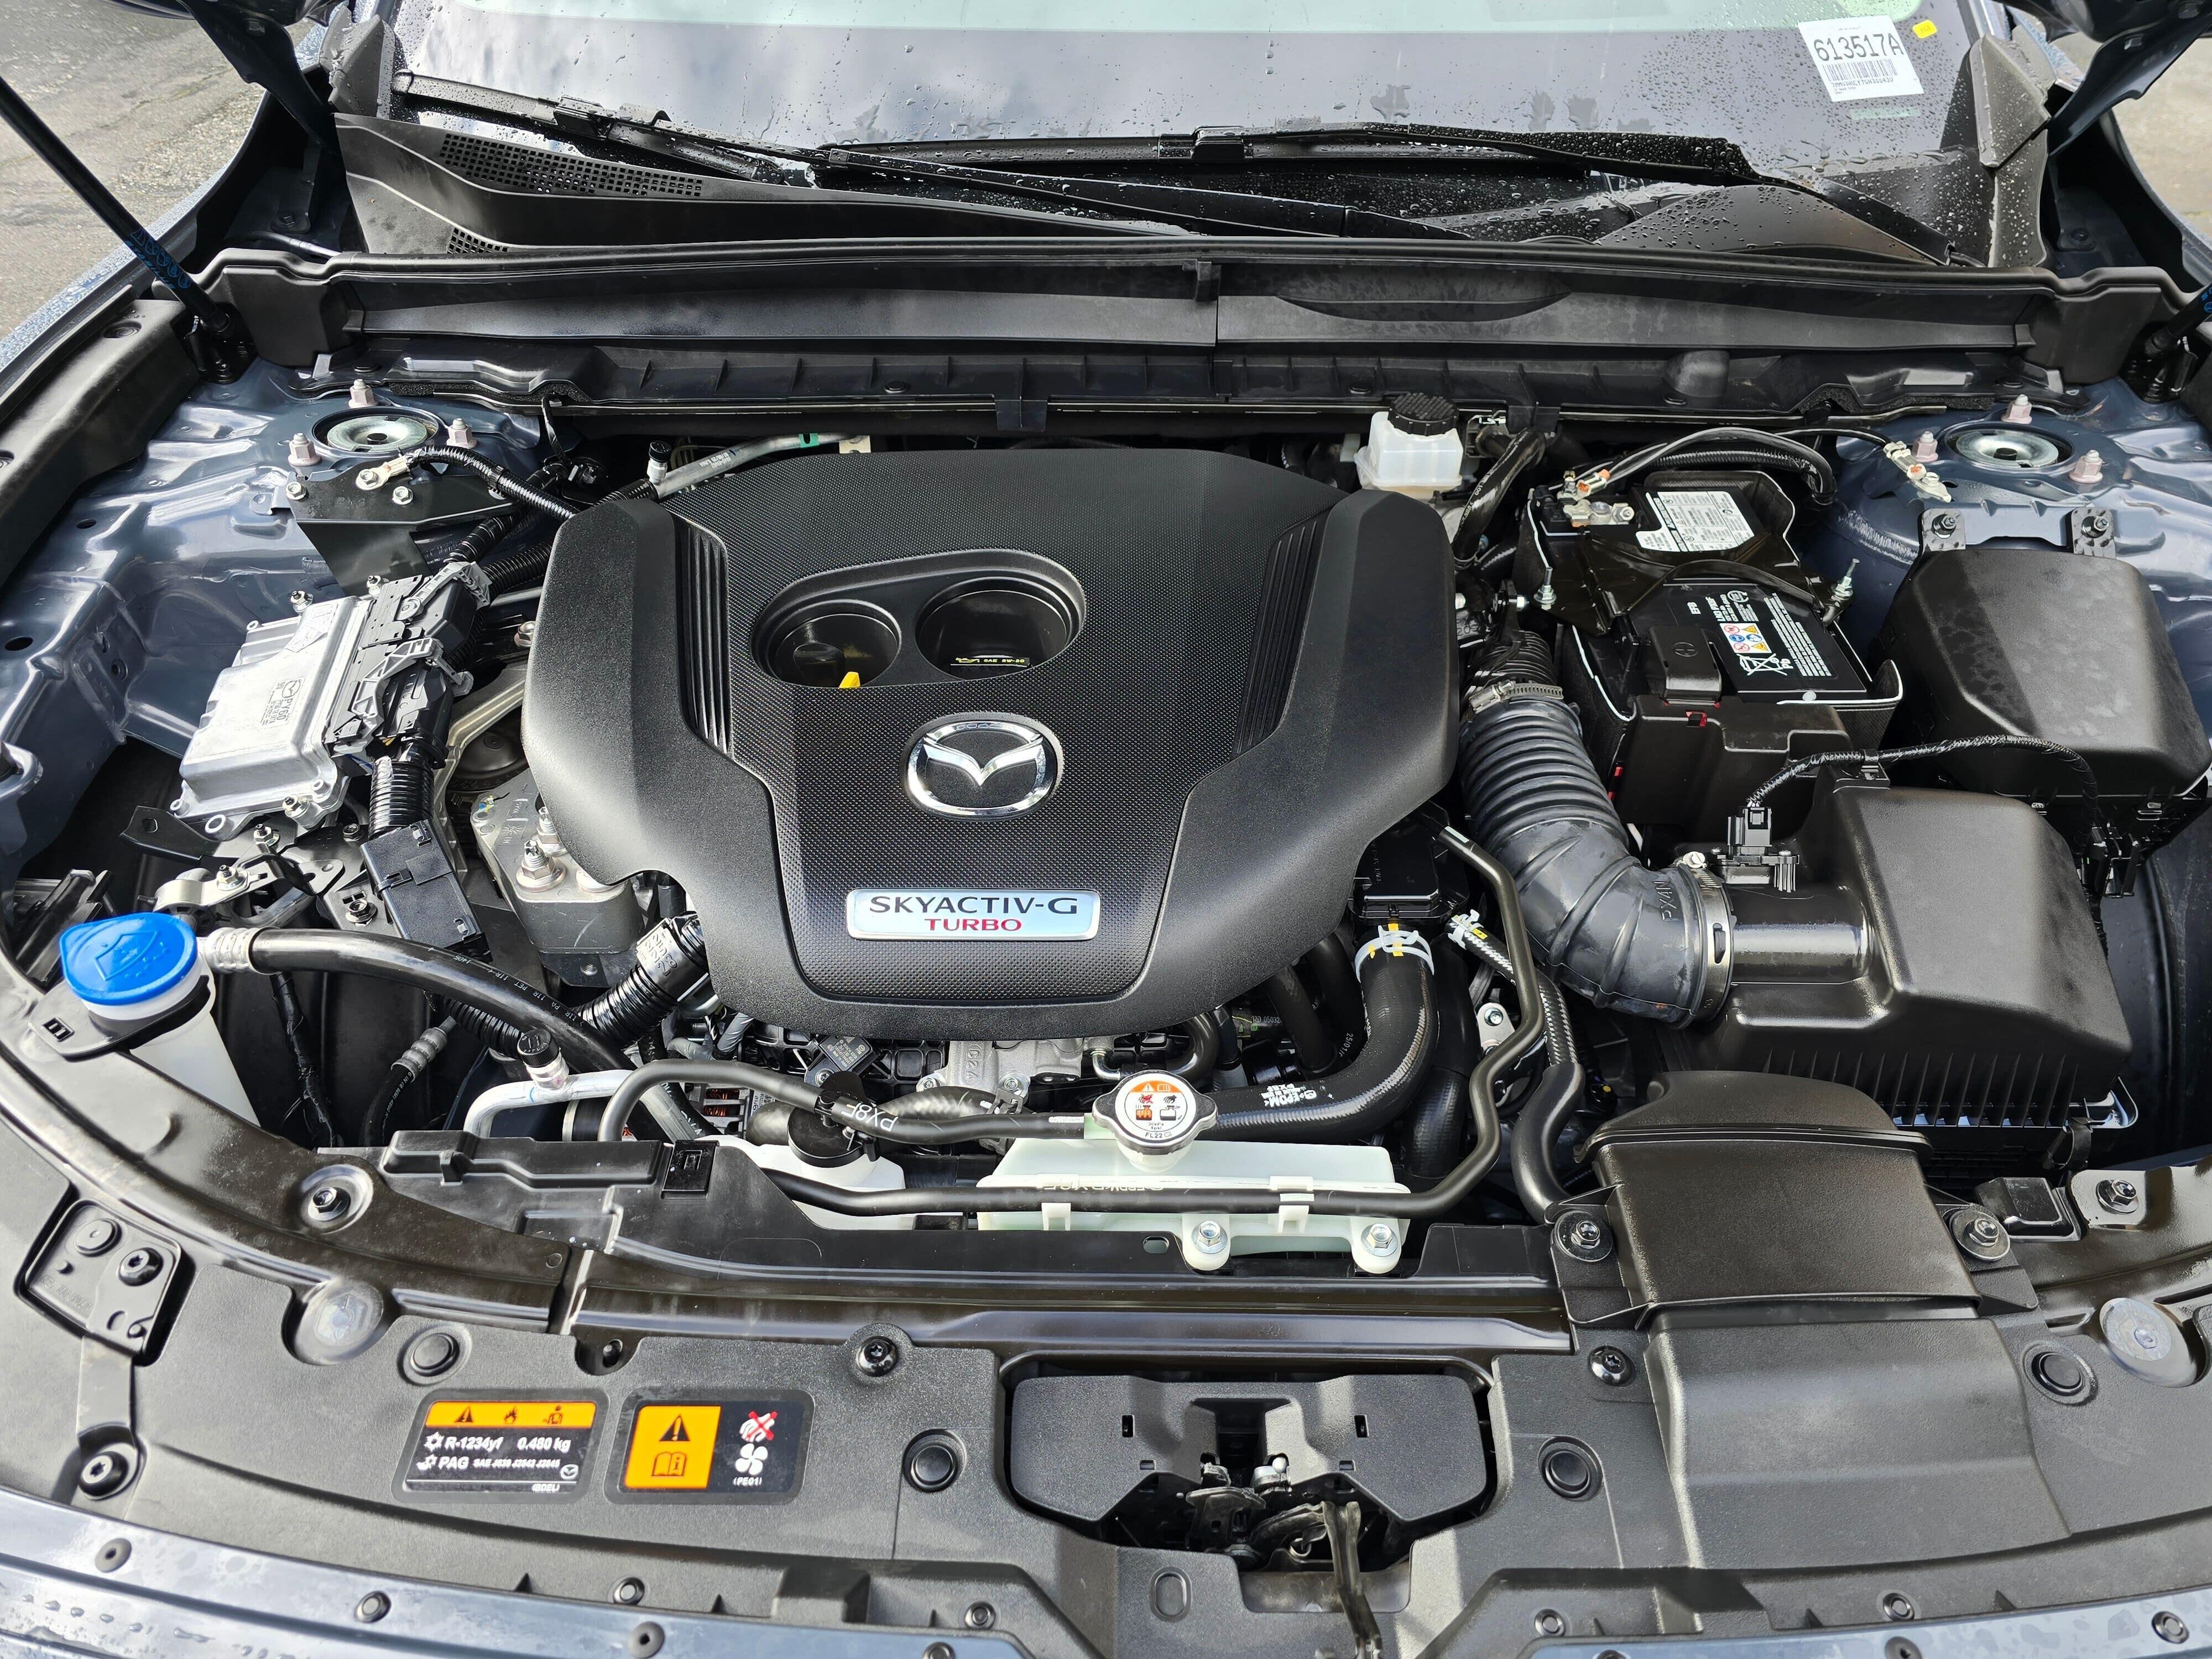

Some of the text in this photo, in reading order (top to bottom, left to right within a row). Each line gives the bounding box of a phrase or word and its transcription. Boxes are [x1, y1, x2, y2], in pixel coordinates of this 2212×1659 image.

[1814, 33, 1904, 61] 613517A
[869, 896, 1078, 915] SKYACTIV-G
[925, 918, 1022, 932] TURBO
[514, 982, 528, 991] PET
[841, 1102, 899, 1132] PX8F
[444, 1436, 504, 1452] R-1234yf
[554, 1438, 571, 1453] kg
[438, 1456, 469, 1469] PAG
[473, 1459, 491, 1467] SAE
[733, 1477, 763, 1486] (PE01)
